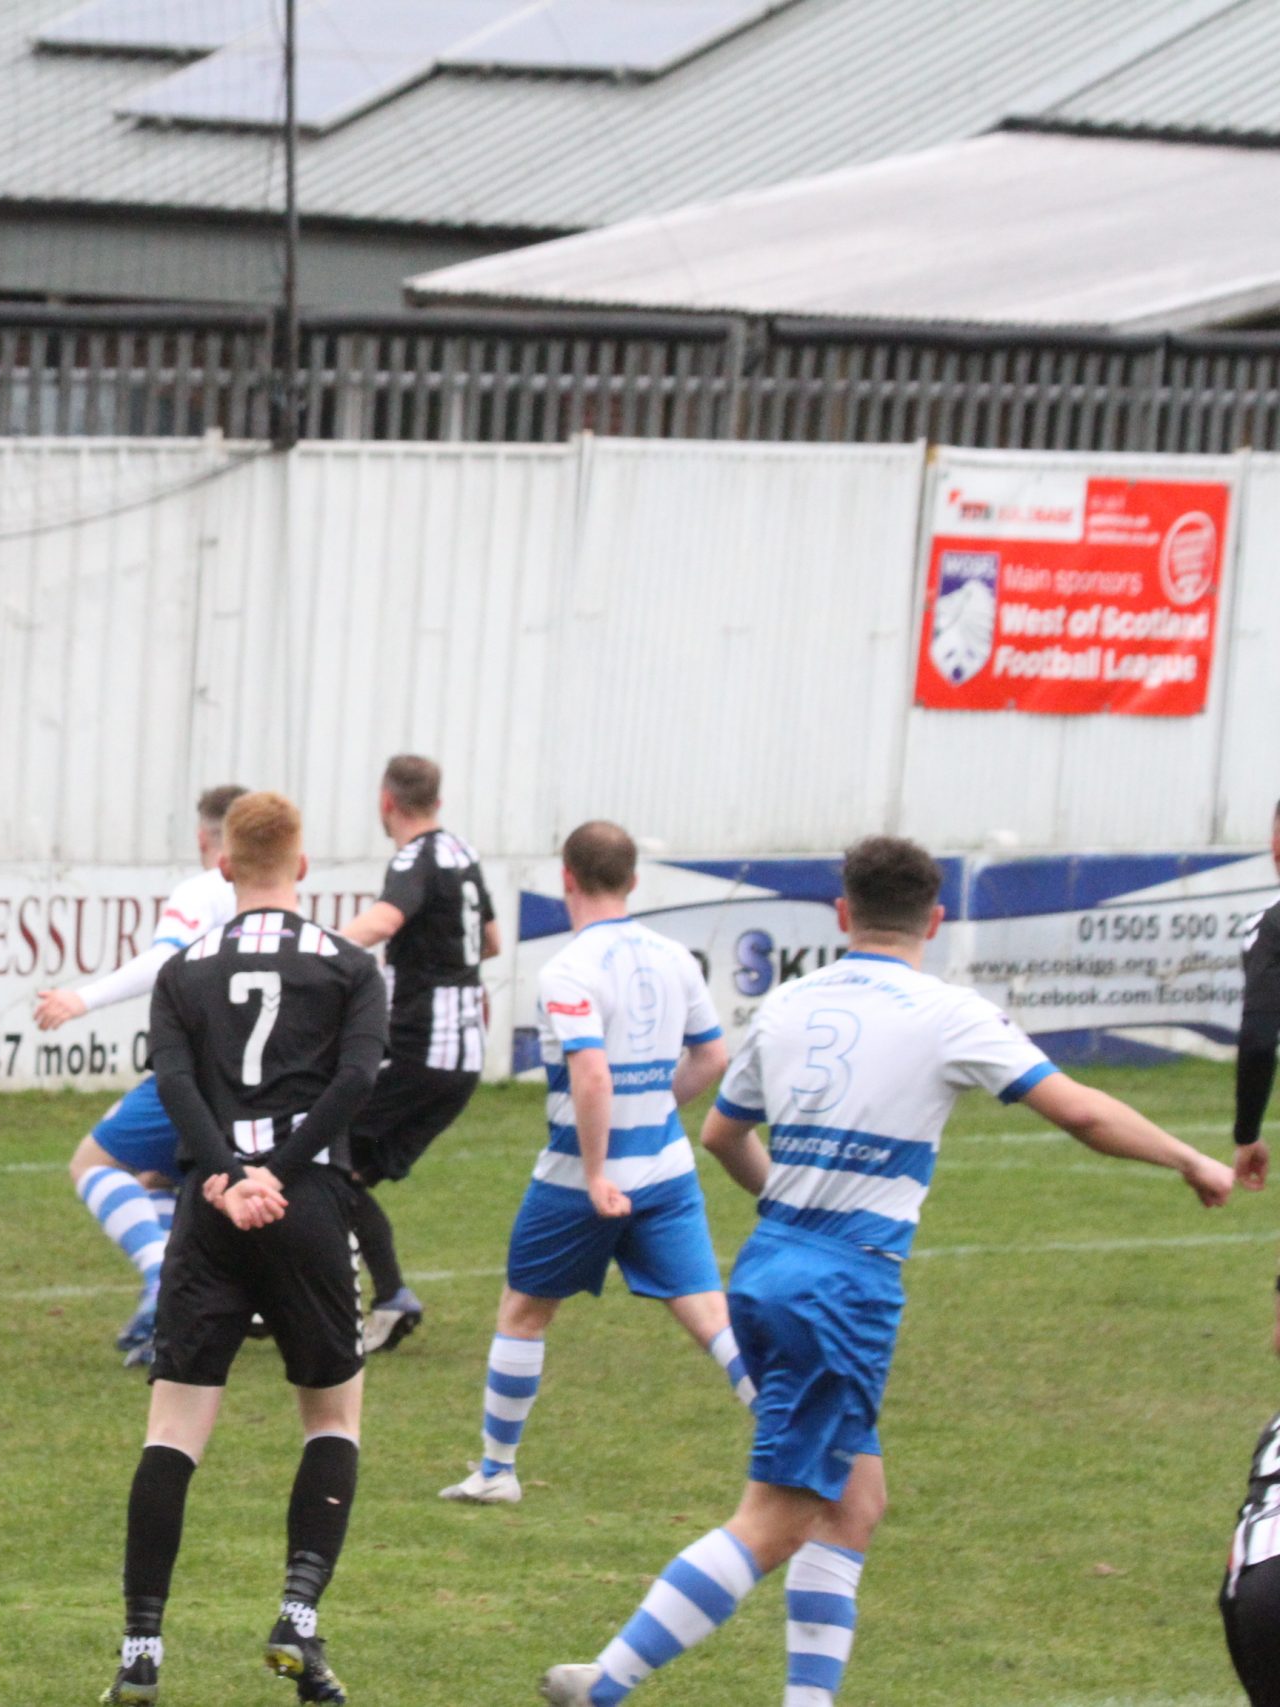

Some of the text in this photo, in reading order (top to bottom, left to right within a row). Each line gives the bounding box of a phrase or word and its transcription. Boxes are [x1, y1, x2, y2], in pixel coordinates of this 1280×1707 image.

[1003, 564, 1144, 597] Main sponsors
[1000, 603, 1209, 641] West of Scotland
[993, 646, 1198, 689] Football League
[1078, 907, 1160, 941] 01505
[1170, 910, 1218, 940] 500
[626, 966, 668, 1054] 9
[1008, 982, 1245, 1009] facebook.com/EcoSkip
[228, 970, 282, 1087] 7
[35, 1030, 118, 1076] mob:
[791, 1008, 862, 1115] 3
